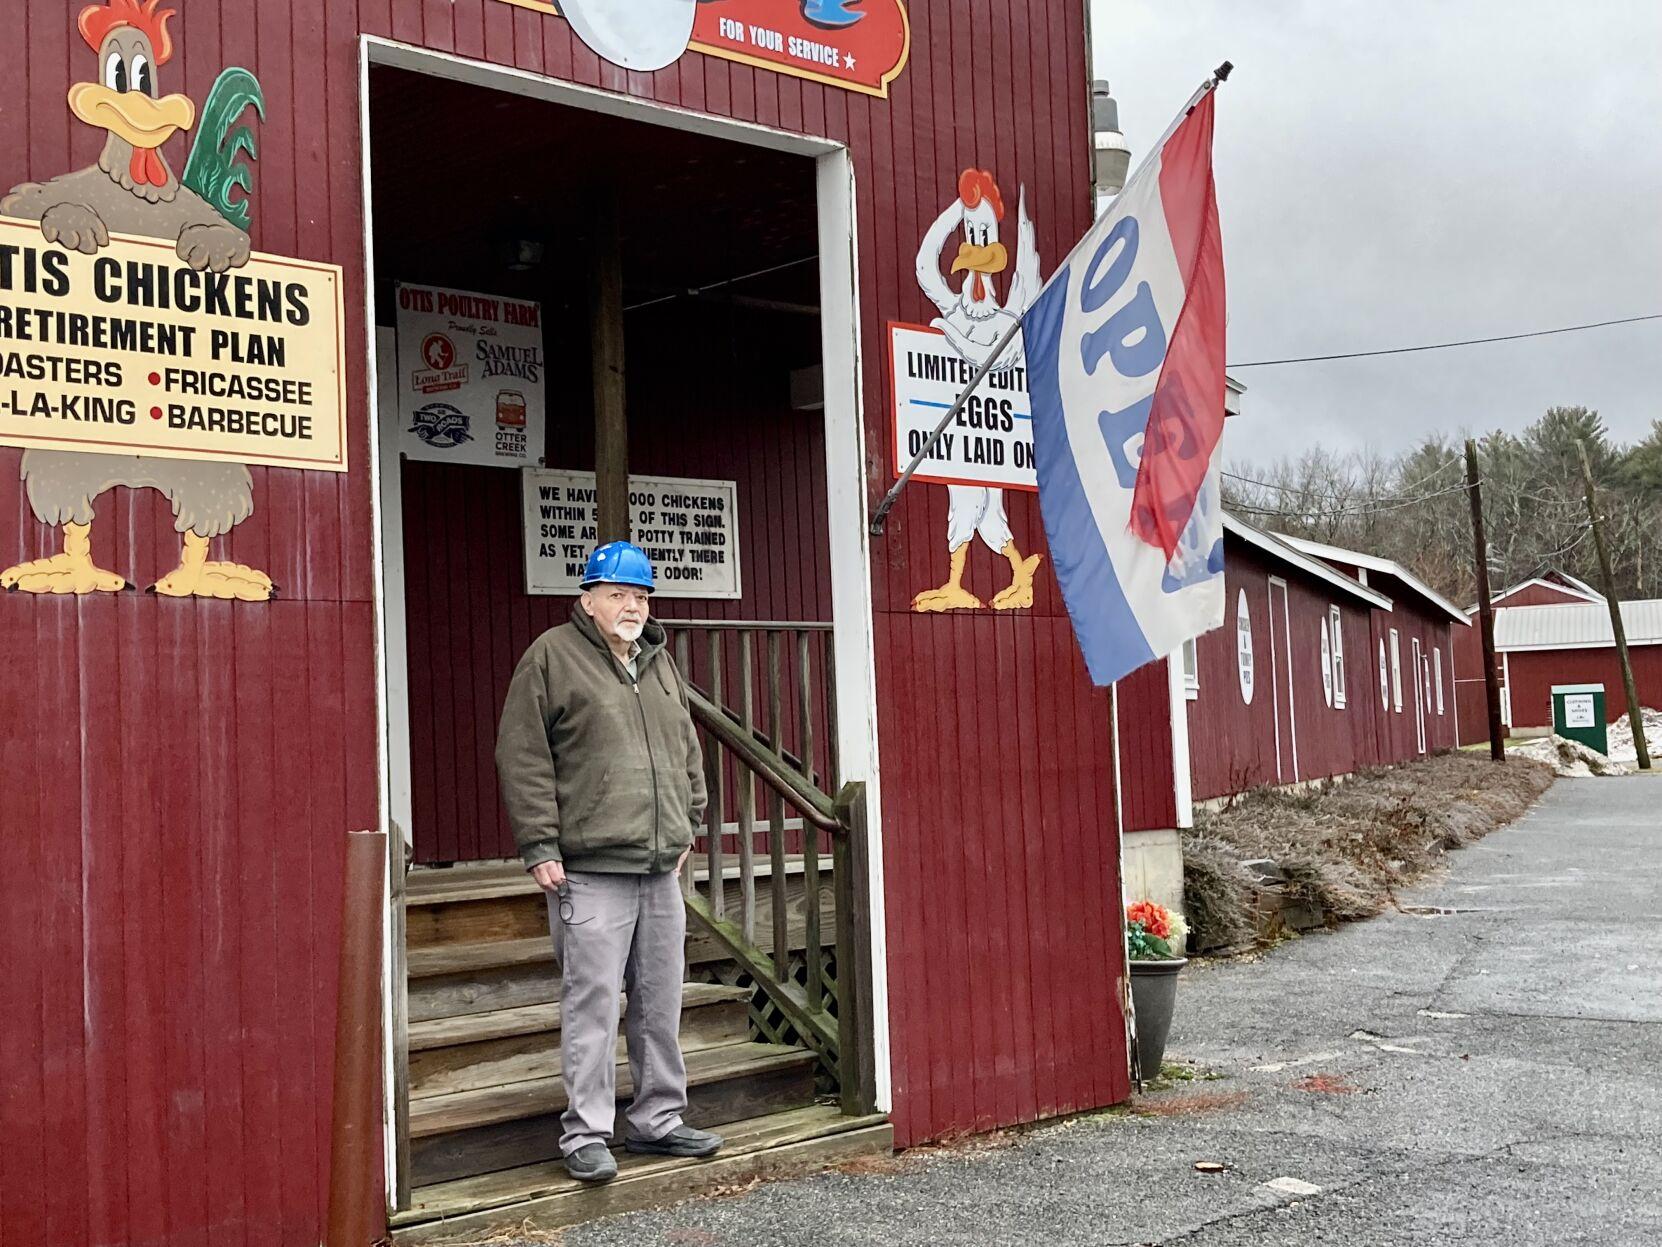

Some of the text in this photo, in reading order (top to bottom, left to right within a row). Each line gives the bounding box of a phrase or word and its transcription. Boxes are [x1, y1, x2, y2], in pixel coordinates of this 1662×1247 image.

[719, 16, 840, 68] FOR YOUR SERVICE
[93, 257, 311, 327] CHICKENS
[399, 288, 539, 328] OTIS POULTRY FARM
[0, 304, 286, 368] RETIREMENT PLAN
[476, 339, 543, 367] SAMUEL
[0, 351, 123, 388] ASTERS
[481, 359, 538, 384] ADAMS
[989, 366, 1030, 394] EDIT
[164, 367, 313, 406] FRICASSEE
[168, 403, 313, 440] BARBECUE
[419, 413, 437, 423] TWO
[436, 416, 463, 432] ROADS
[955, 393, 1014, 433] EGGS
[495, 431, 527, 443] OTTER
[495, 441, 527, 453] CREEK
[908, 429, 954, 462] ONLY
[964, 435, 1005, 467] LAID
[539, 486, 560, 501] WE
[661, 494, 725, 511] CHICKENS
[540, 505, 586, 521] WITHIN
[639, 511, 656, 525] OF
[661, 512, 688, 527] THIS
[693, 514, 726, 529] SIGN.
[540, 523, 726, 546] SOME AR POTTY TRAINED
[539, 543, 556, 558] AS
[562, 544, 589, 562] YET,
[689, 549, 725, 564] THERE
[566, 563, 588, 577] MA
[664, 566, 703, 581] ODOR!
